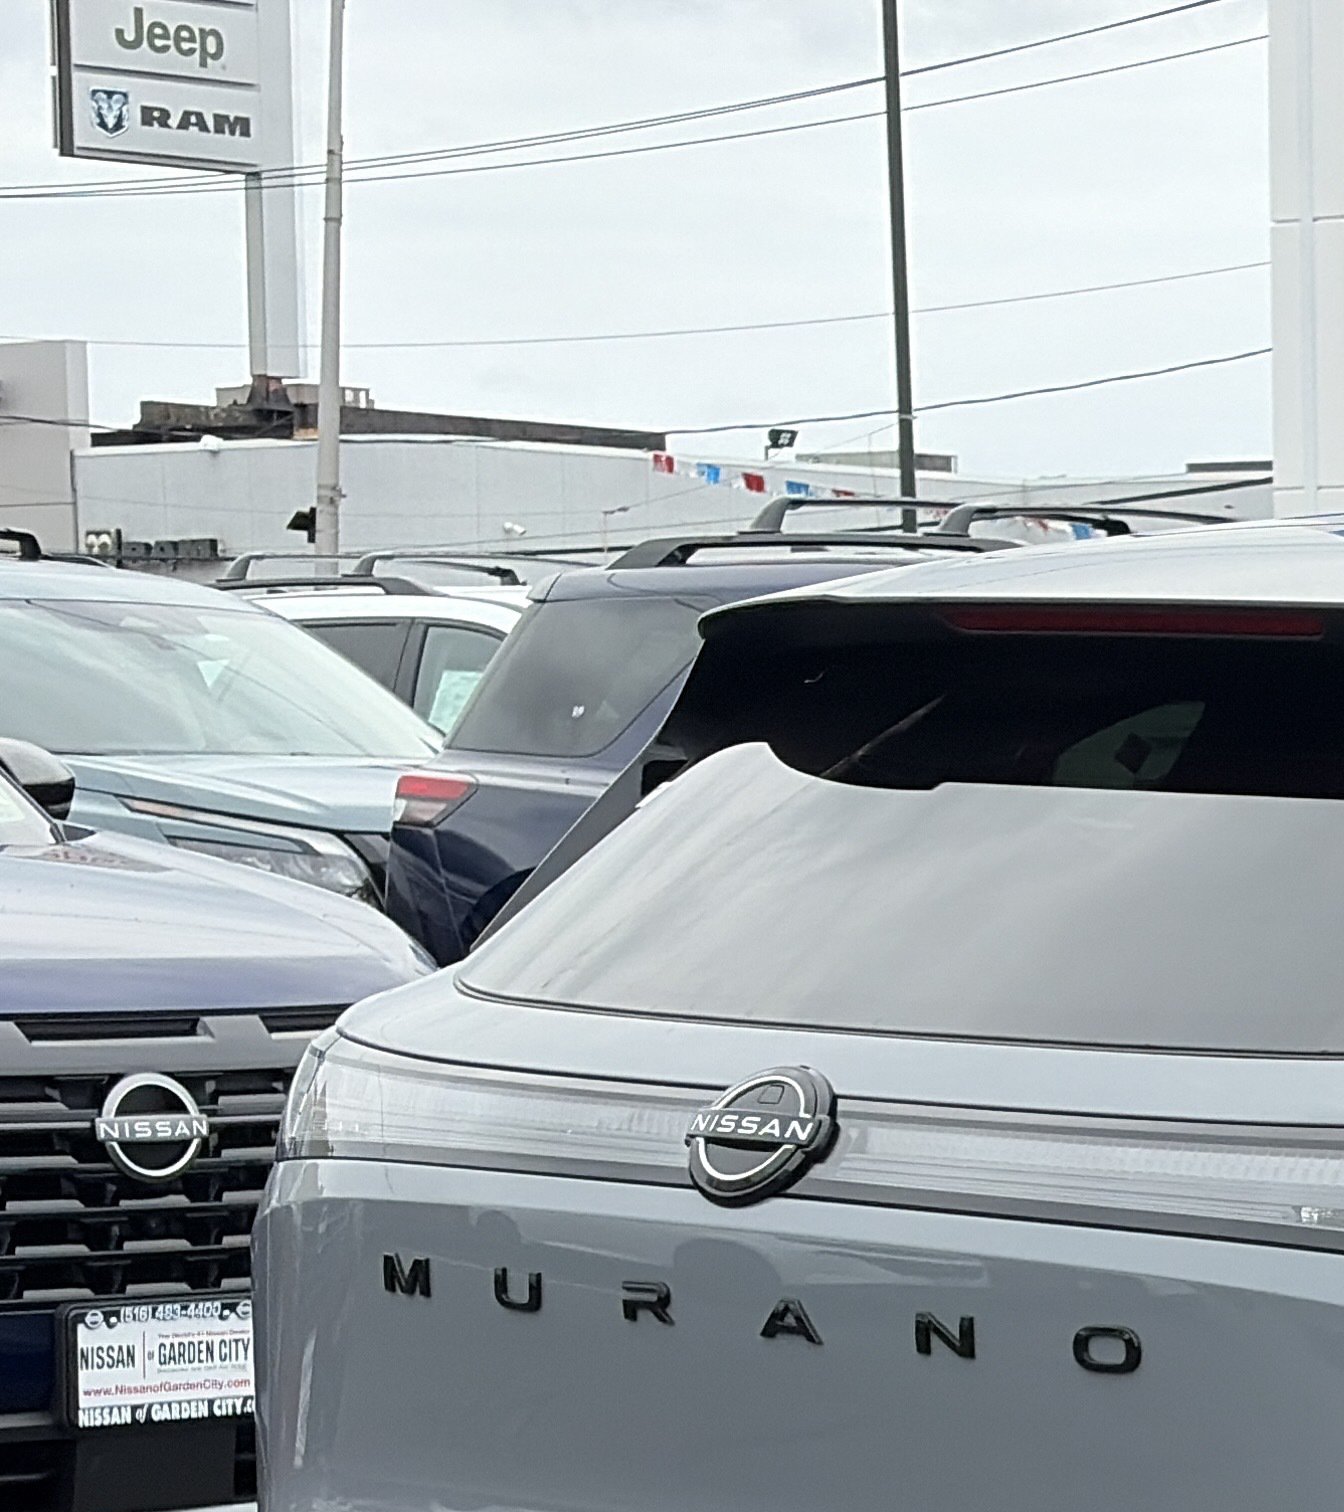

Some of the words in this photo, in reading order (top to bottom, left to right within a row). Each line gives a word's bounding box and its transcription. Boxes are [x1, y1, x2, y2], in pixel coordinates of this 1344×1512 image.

[115, 7, 225, 68] Jeep
[140, 105, 252, 138] RAM
[99, 1118, 208, 1138] NISSAN
[690, 1113, 814, 1141] NISSAN
[382, 1252, 1143, 1375] MURANO
[79, 1344, 136, 1370] NISSAN
[158, 1339, 214, 1366] GARDEN
[218, 1337, 250, 1362] CITY
[78, 1405, 132, 1428] NISSAN
[136, 1403, 149, 1424] of
[151, 1401, 209, 1422] GARDEN
[213, 1396, 256, 1417] CITY.c
